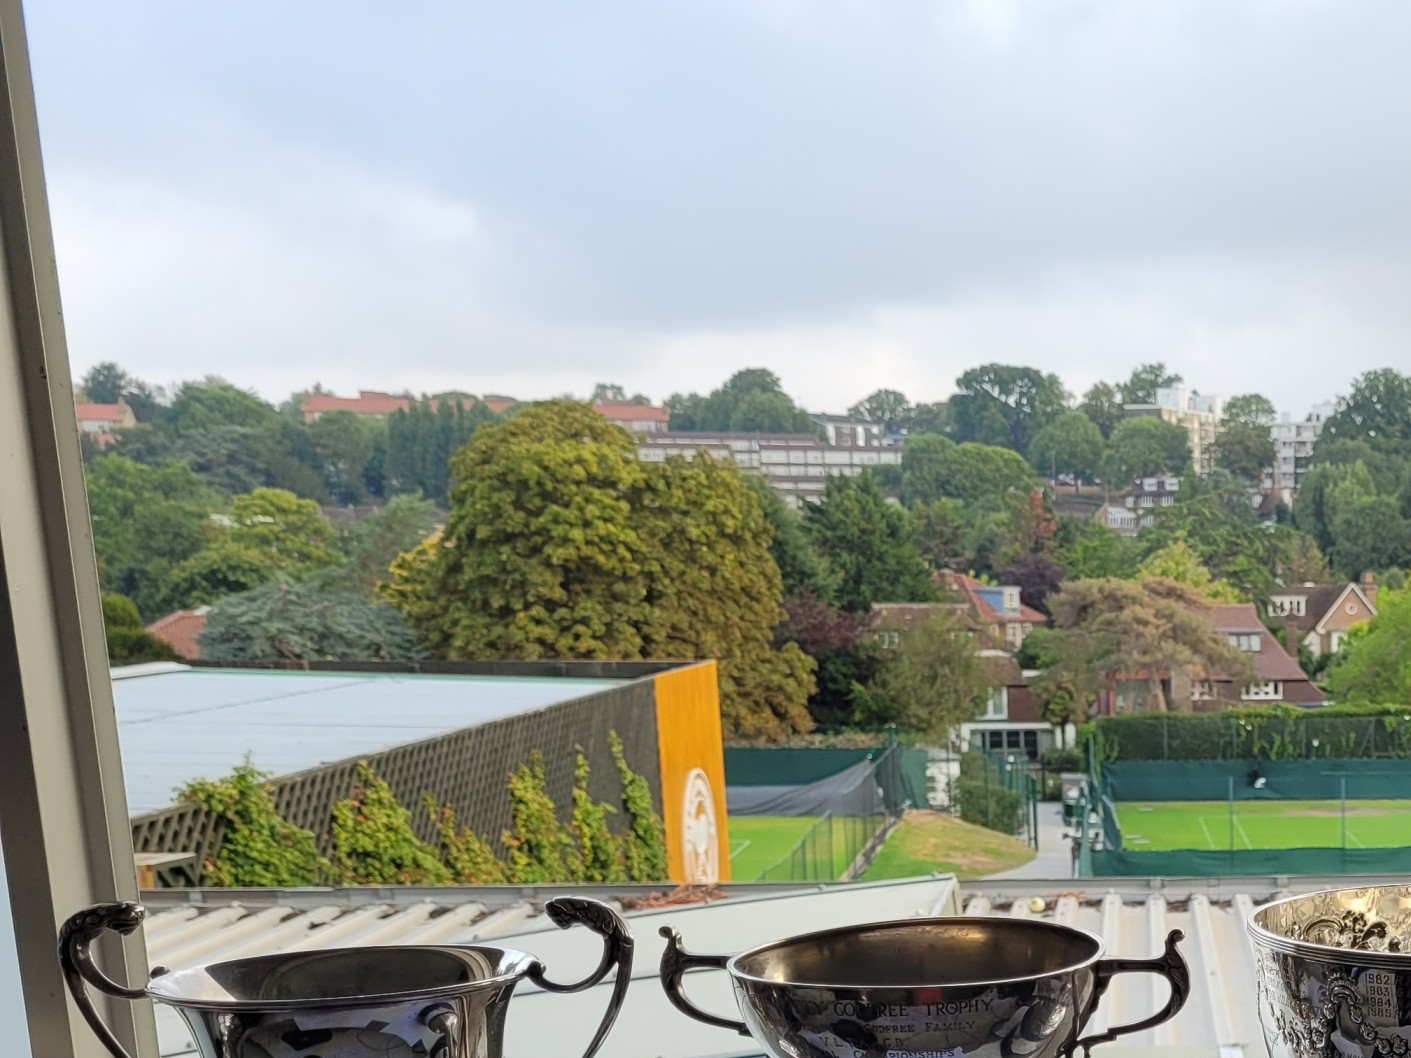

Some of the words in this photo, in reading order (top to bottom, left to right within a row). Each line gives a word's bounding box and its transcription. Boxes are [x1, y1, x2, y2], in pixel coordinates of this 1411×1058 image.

[1365, 973, 1390, 986] 1982
[1366, 986, 1391, 997] 1983
[925, 998, 995, 1016] TROPHY
[1366, 997, 1392, 1008] 1984
[925, 1021, 976, 1032] FAMILY
